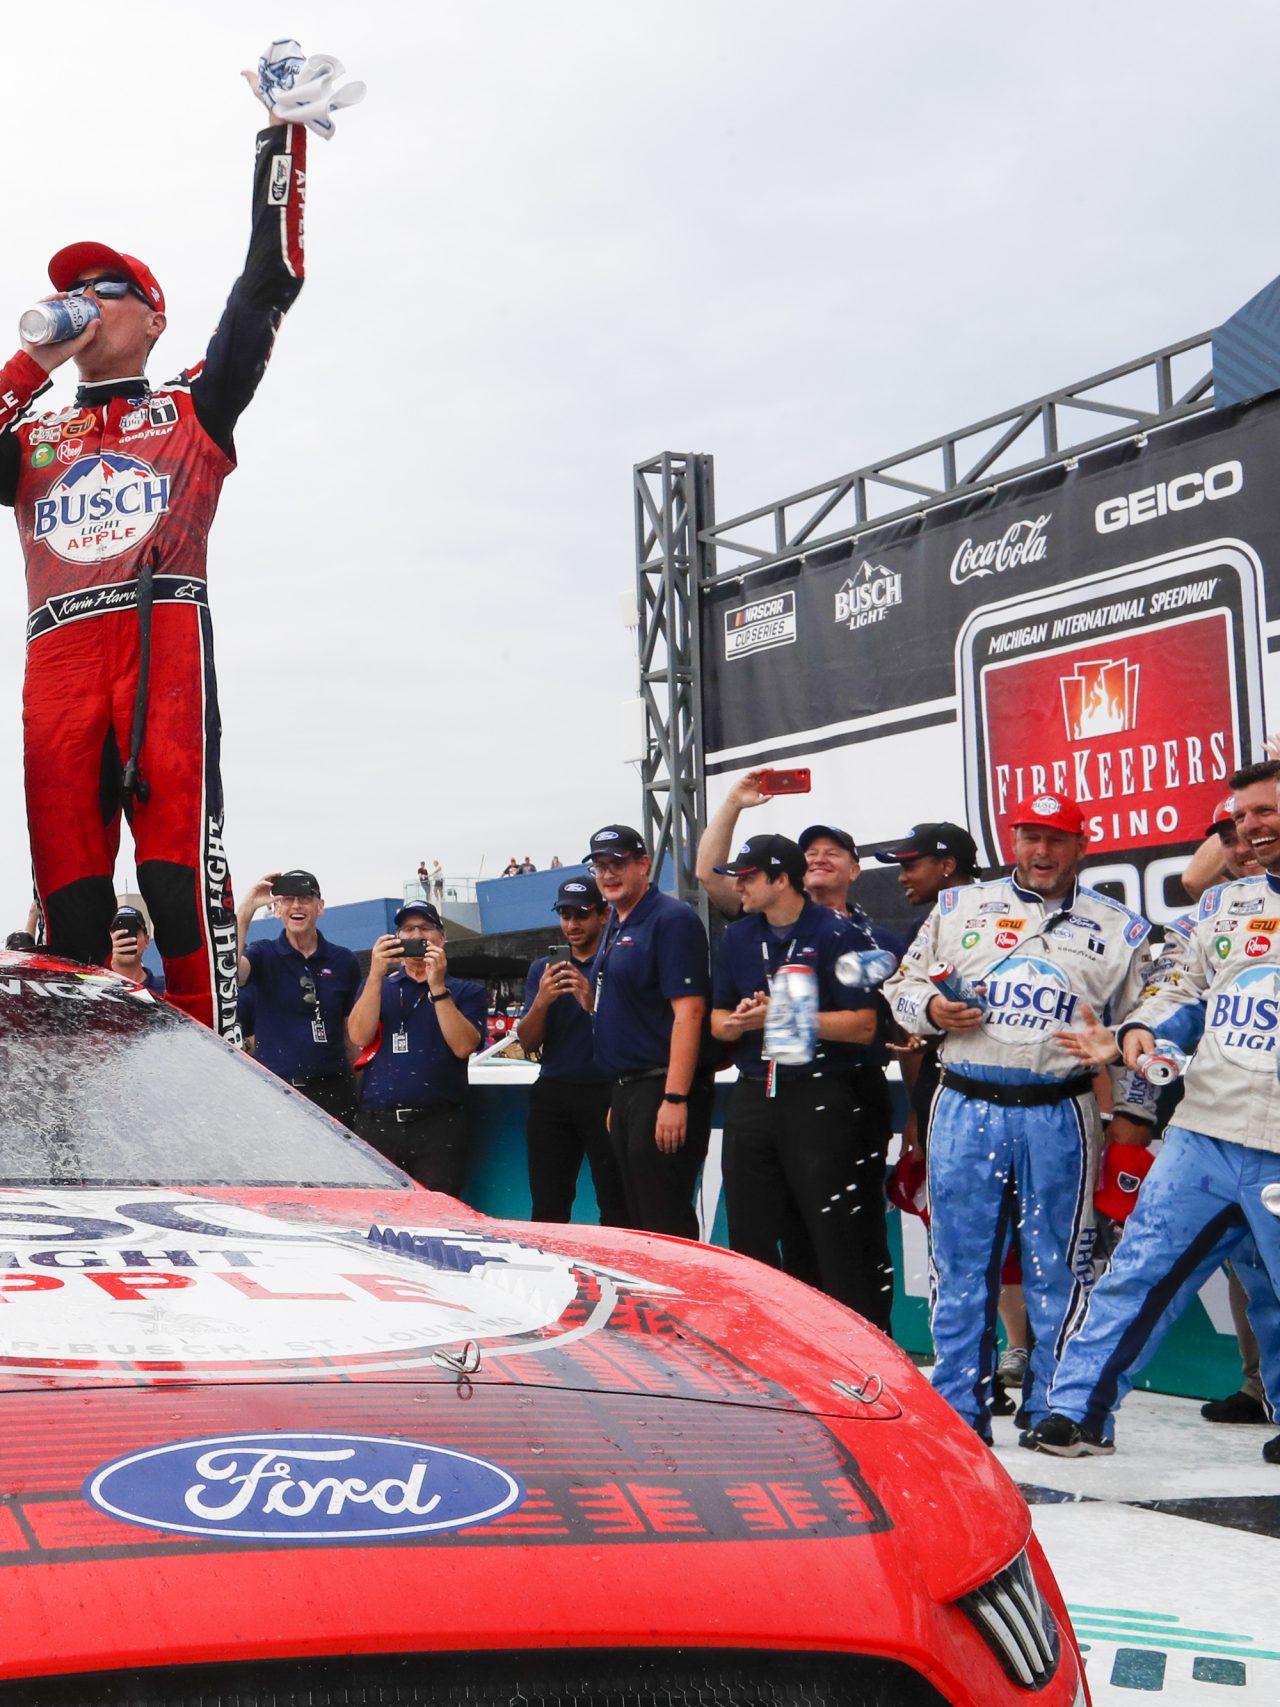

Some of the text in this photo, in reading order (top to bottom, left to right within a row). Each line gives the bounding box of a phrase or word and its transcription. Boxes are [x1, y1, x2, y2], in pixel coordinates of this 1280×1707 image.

[156, 407, 169, 424] 1
[34, 477, 170, 539] BUSCH
[1095, 460, 1243, 534] GEICO
[67, 527, 137, 551] APPLE
[81, 519, 121, 536] LIGHT
[950, 512, 1053, 586] Coca-Cola
[58, 596, 94, 617] Kevin
[744, 598, 784, 623] NASCAR
[835, 574, 903, 623] BUSCH
[988, 578, 1218, 655] MICHIGAN INTERNATIONAL SPEEDWAY
[735, 620, 785, 648] CUP SERIES
[995, 731, 1228, 816] FIREKEEPERS
[207, 815, 227, 917] LIGHT
[214, 923, 244, 1051] BUSCH
[985, 1011, 1054, 1031] LIGHT
[184, 1446, 442, 1520] Ford
